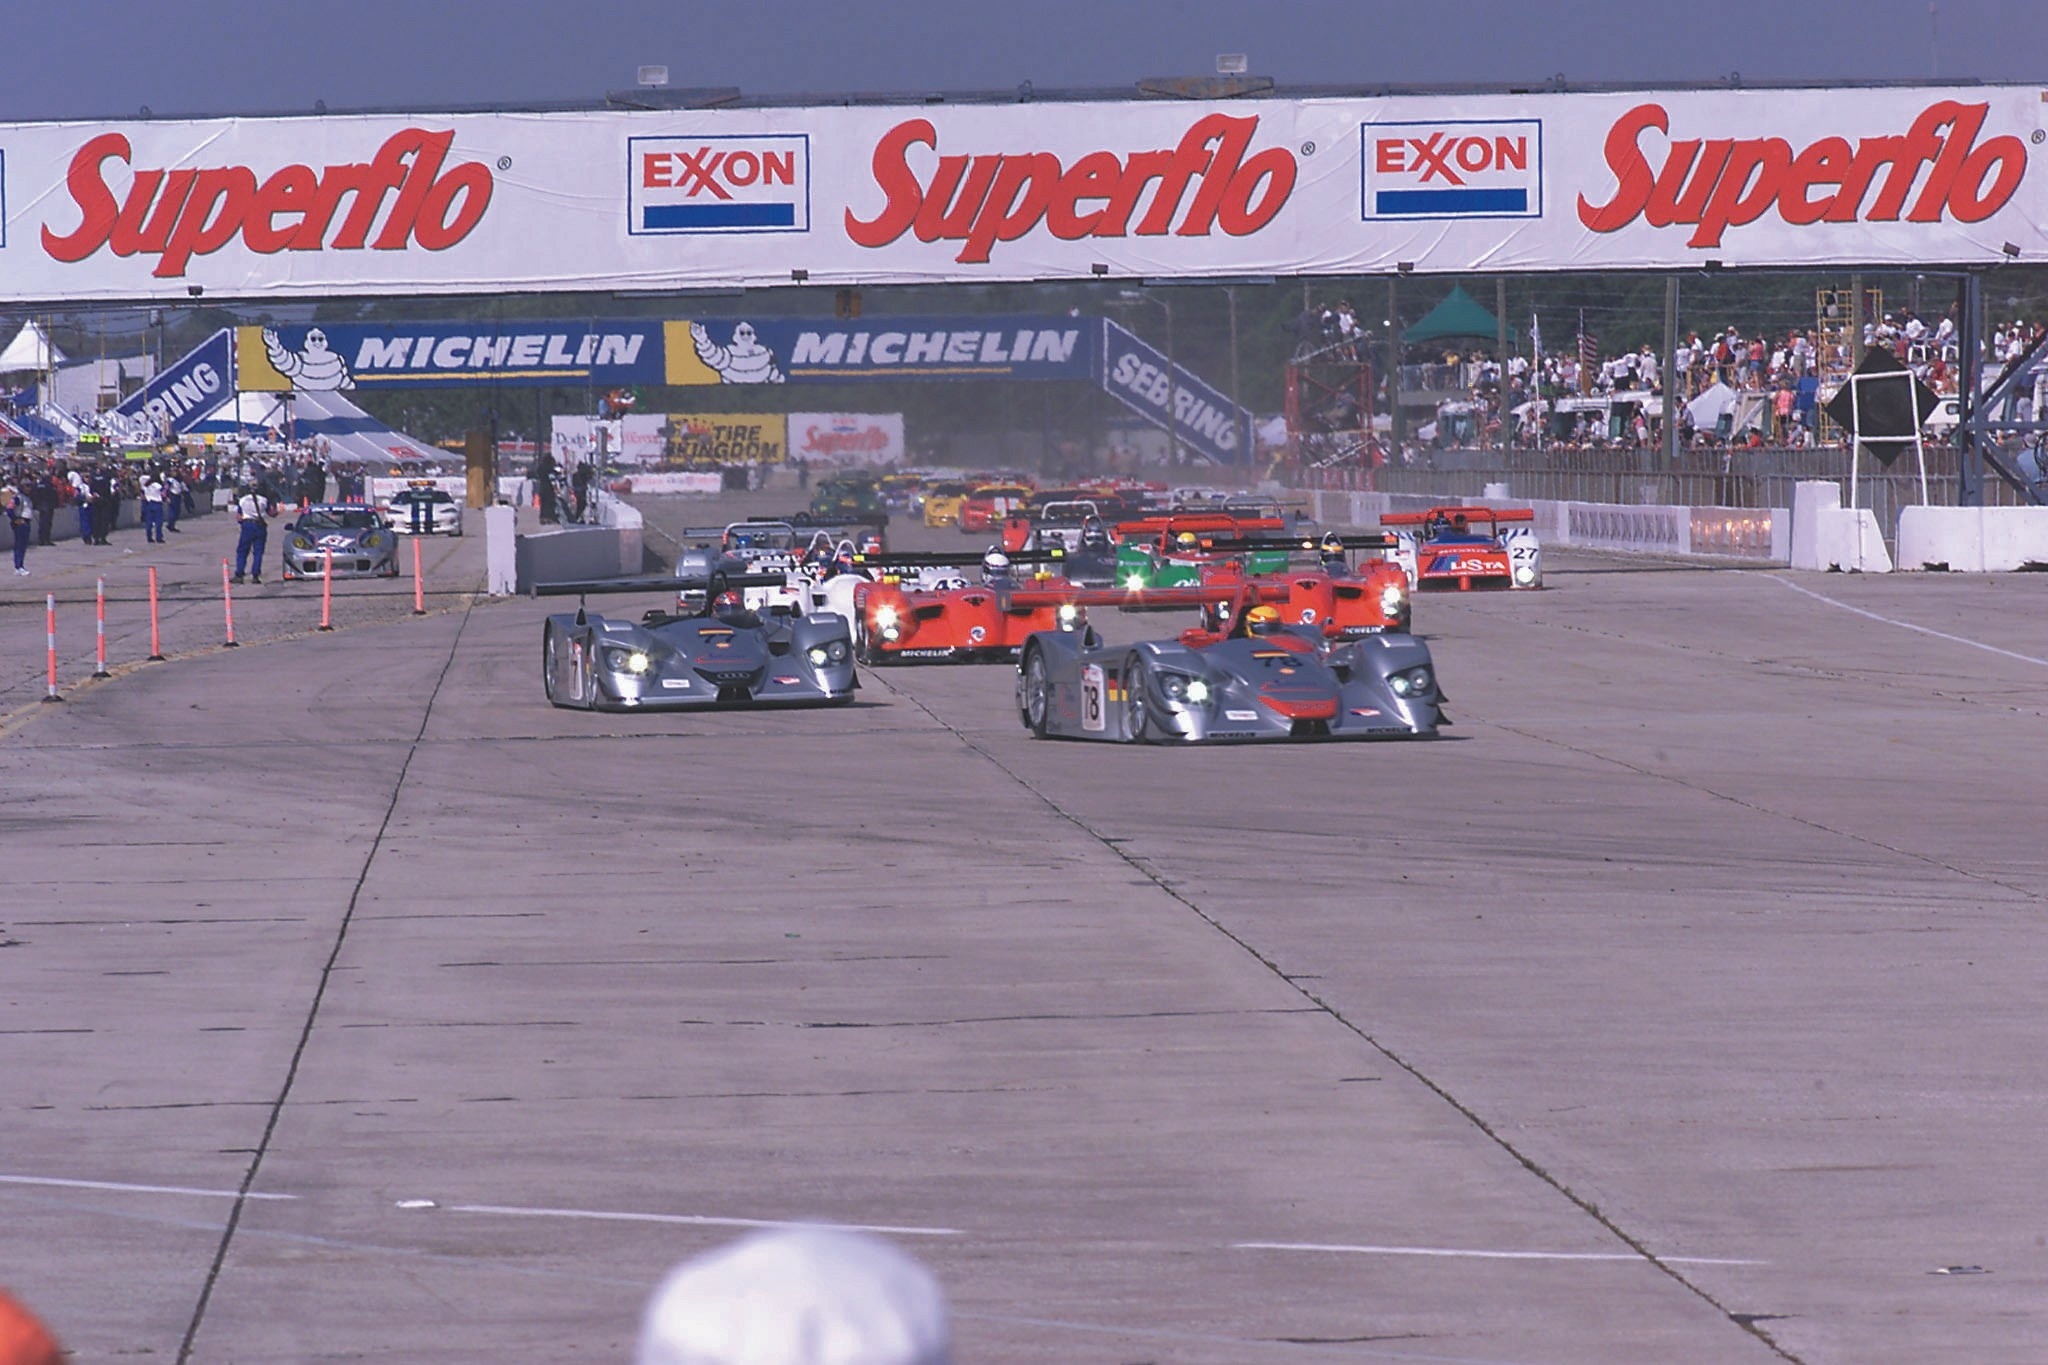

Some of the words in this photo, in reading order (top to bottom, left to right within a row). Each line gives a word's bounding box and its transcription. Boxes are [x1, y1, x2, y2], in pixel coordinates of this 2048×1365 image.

[643, 148, 795, 200] EXXON
[1376, 132, 1527, 186] EXXON
[1577, 101, 2028, 248] Superflo
[41, 128, 494, 278] Superflo
[844, 113, 1297, 263] Superflo
[354, 334, 644, 369] MICHELIN
[791, 330, 1078, 364] MICHELIN
[713, 425, 762, 441] TIRE
[1450, 558, 1505, 571] LISTA
[1513, 547, 1538, 559] 27
[900, 648, 951, 657] MICHELIN
